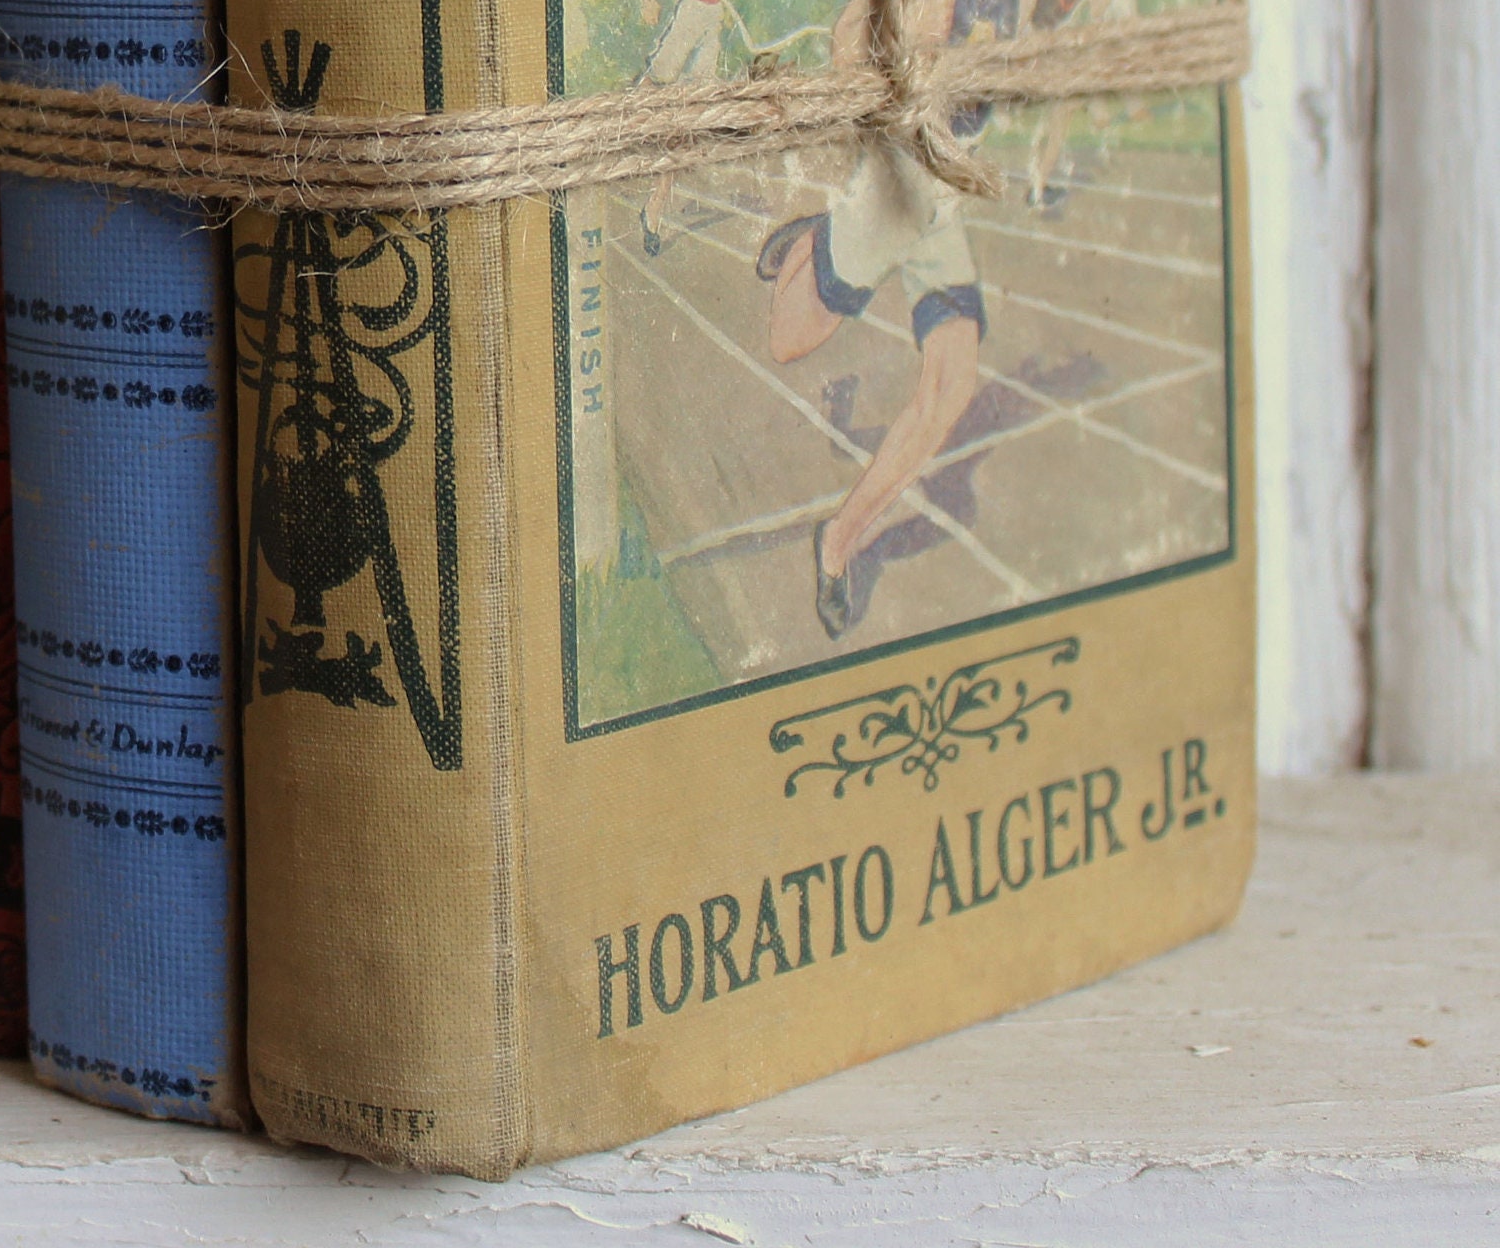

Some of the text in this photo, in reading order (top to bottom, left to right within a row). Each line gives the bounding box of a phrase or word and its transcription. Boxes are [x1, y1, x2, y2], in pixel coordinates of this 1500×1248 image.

[580, 227, 603, 414] FINISH
[111, 723, 224, 767] Dunlap
[594, 845, 895, 1040] HORATIO
[917, 766, 1128, 926] ALGER
